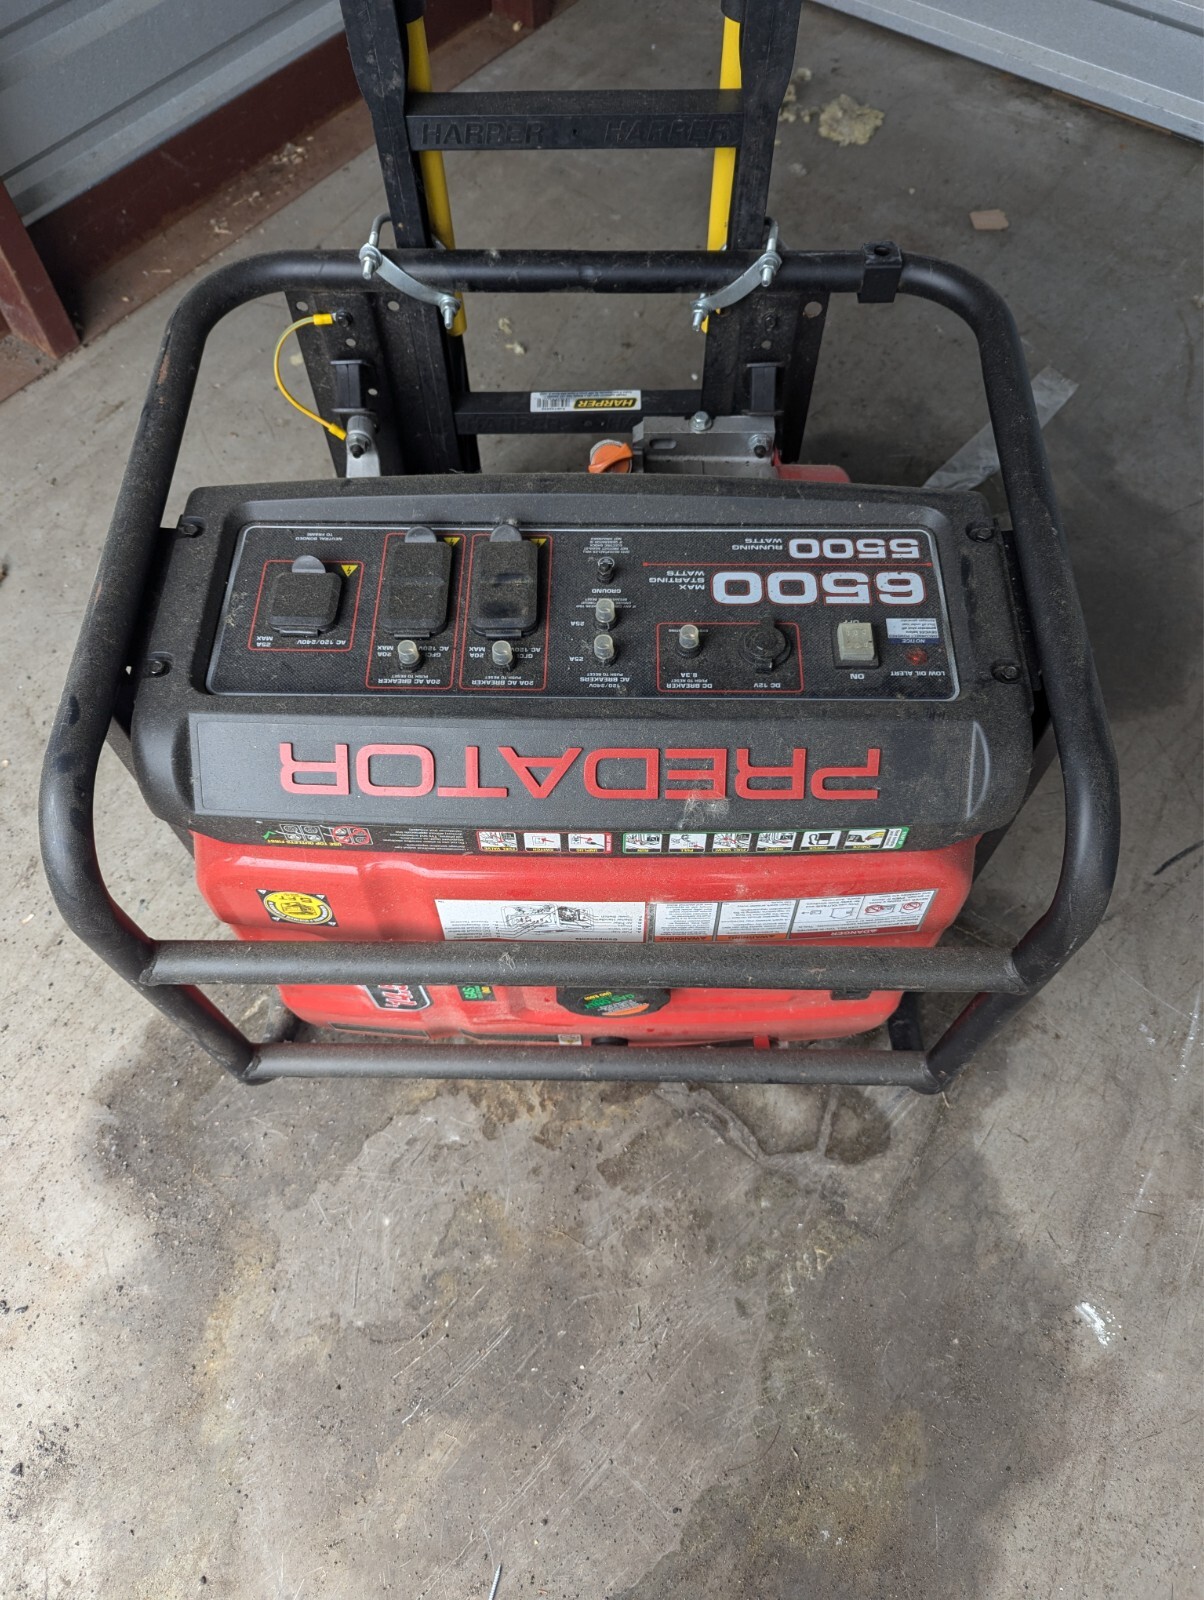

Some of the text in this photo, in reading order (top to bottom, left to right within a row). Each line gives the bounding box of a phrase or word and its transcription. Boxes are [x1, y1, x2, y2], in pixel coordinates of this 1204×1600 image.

[421, 122, 545, 145] HARPER
[604, 120, 733, 143] HARPER
[577, 399, 634, 407] HARPER
[788, 538, 920, 559] 5500
[712, 571, 925, 605] 6500
[278, 742, 882, 800] PREDATOR
[462, 987, 477, 999] GAS
